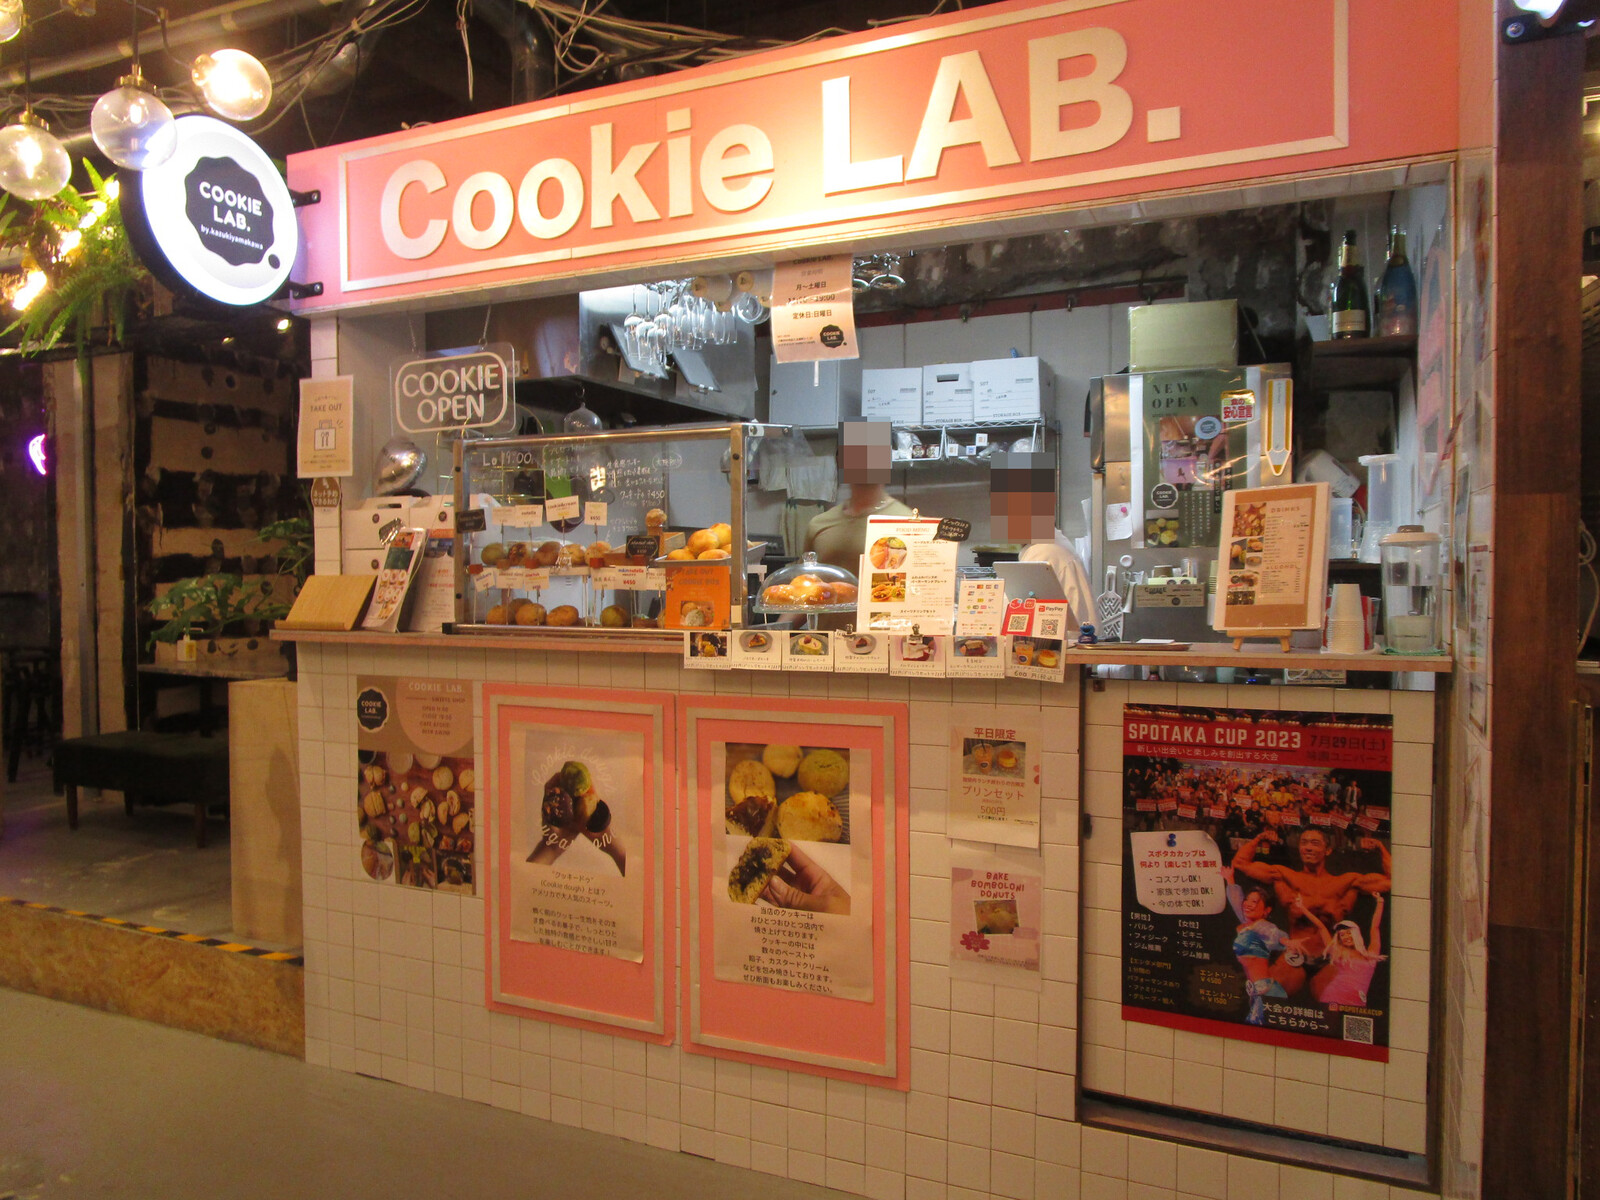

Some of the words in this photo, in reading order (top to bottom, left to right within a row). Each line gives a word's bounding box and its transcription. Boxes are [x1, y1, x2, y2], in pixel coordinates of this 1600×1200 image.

[380, 107, 776, 261] Cookie
[822, 26, 1182, 198] LAB.
[199, 181, 262, 216] COOKIE
[213, 205, 251, 232] LAB.
[402, 364, 500, 398] COOKIE
[1152, 382, 1189, 395] NEW
[310, 404, 326, 413] TAKE
[329, 402, 343, 411] OUT
[417, 393, 485, 424] OPEN
[1152, 396, 1199, 410] OPEN
[1223, 406, 1253, 420] 安心宣言
[408, 682, 442, 692] COOKIE
[361, 700, 382, 708] COOKIE
[974, 727, 1016, 740] 平日限定
[1128, 723, 1207, 744] SPOTAKA
[1214, 728, 1248, 746] CUP
[1255, 730, 1301, 749] 2023
[1310, 734, 1386, 751] 7月29日(土)
[962, 785, 1025, 800] プリンセット
[980, 805, 1006, 817] 500円
[986, 872, 1009, 880] BAKE
[971, 880, 1025, 892] BOMBOLONI
[980, 890, 1016, 900] DONUTS
[760, 906, 814, 920] 当店のクッキーは
[751, 916, 824, 932] おひとつおひとつ店内で
[754, 925, 818, 941] 焼き上げております。
[761, 937, 815, 950] クッキーの中には
[743, 963, 833, 984] などを包み焼きしております。
[1262, 1002, 1325, 1019] 大会の詳細は
